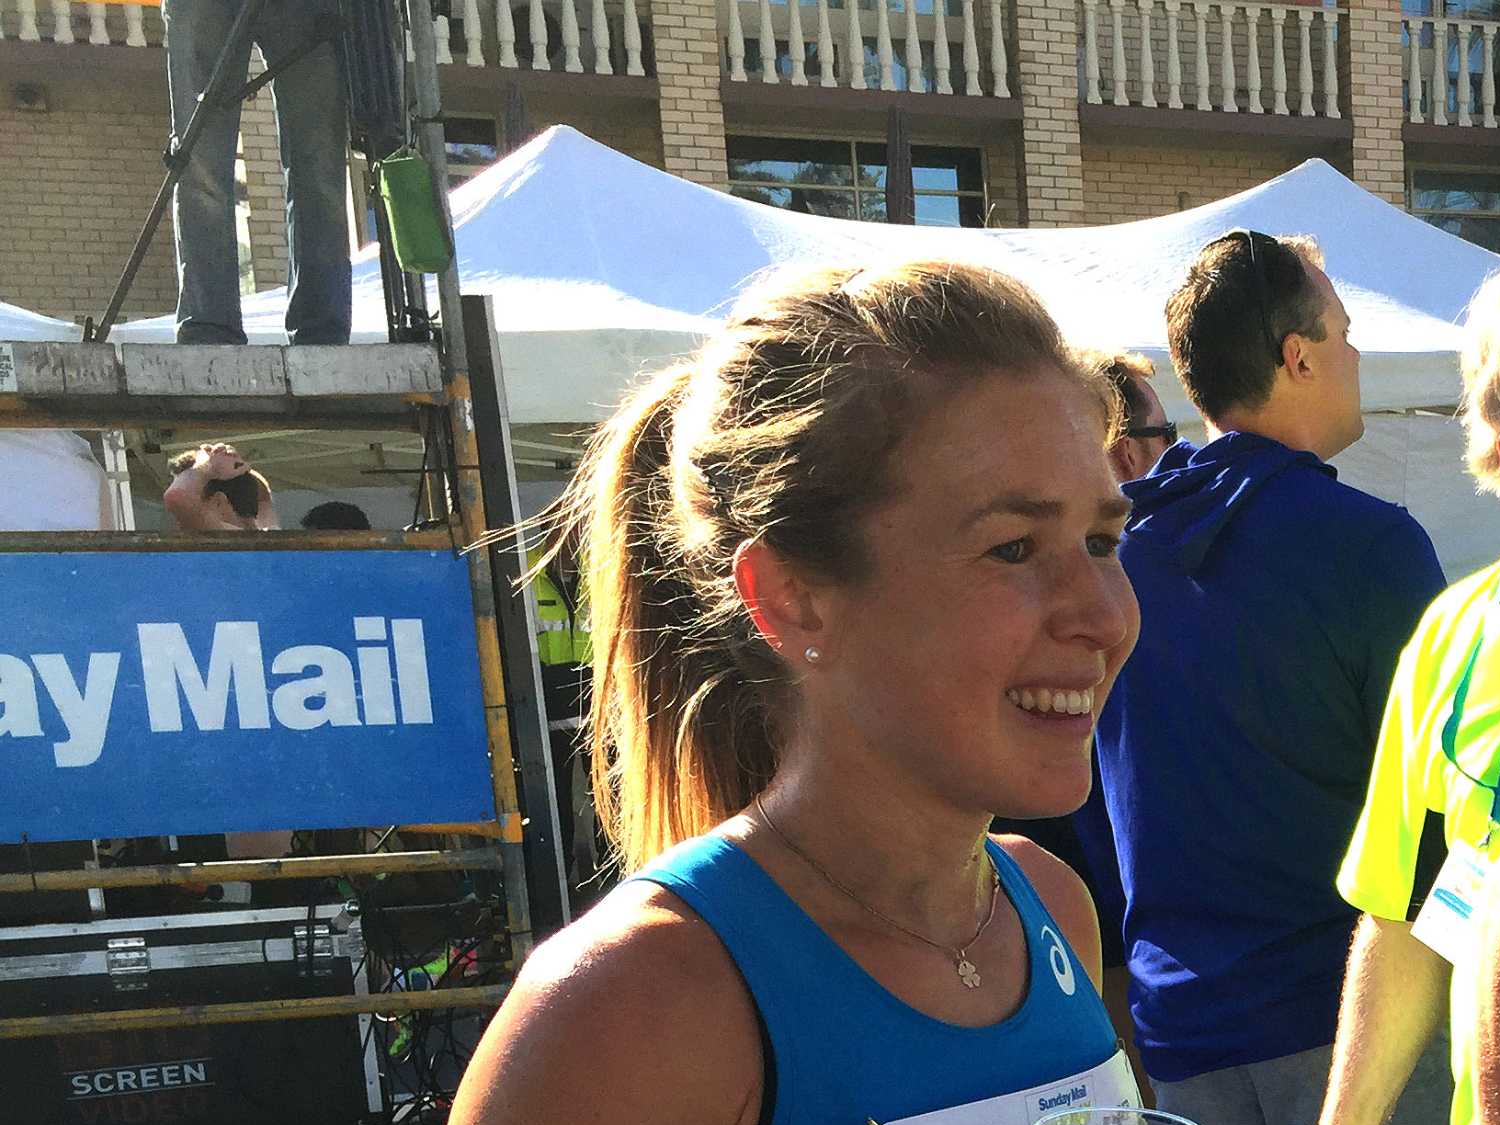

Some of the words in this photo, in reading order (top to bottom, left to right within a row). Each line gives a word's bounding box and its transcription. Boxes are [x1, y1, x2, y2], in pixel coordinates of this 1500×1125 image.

[136, 615, 434, 733] Mail
[71, 1063, 206, 1095] SCREEN
[1039, 1091, 1072, 1111] Sunday
[1070, 1085, 1087, 1101] Mail
